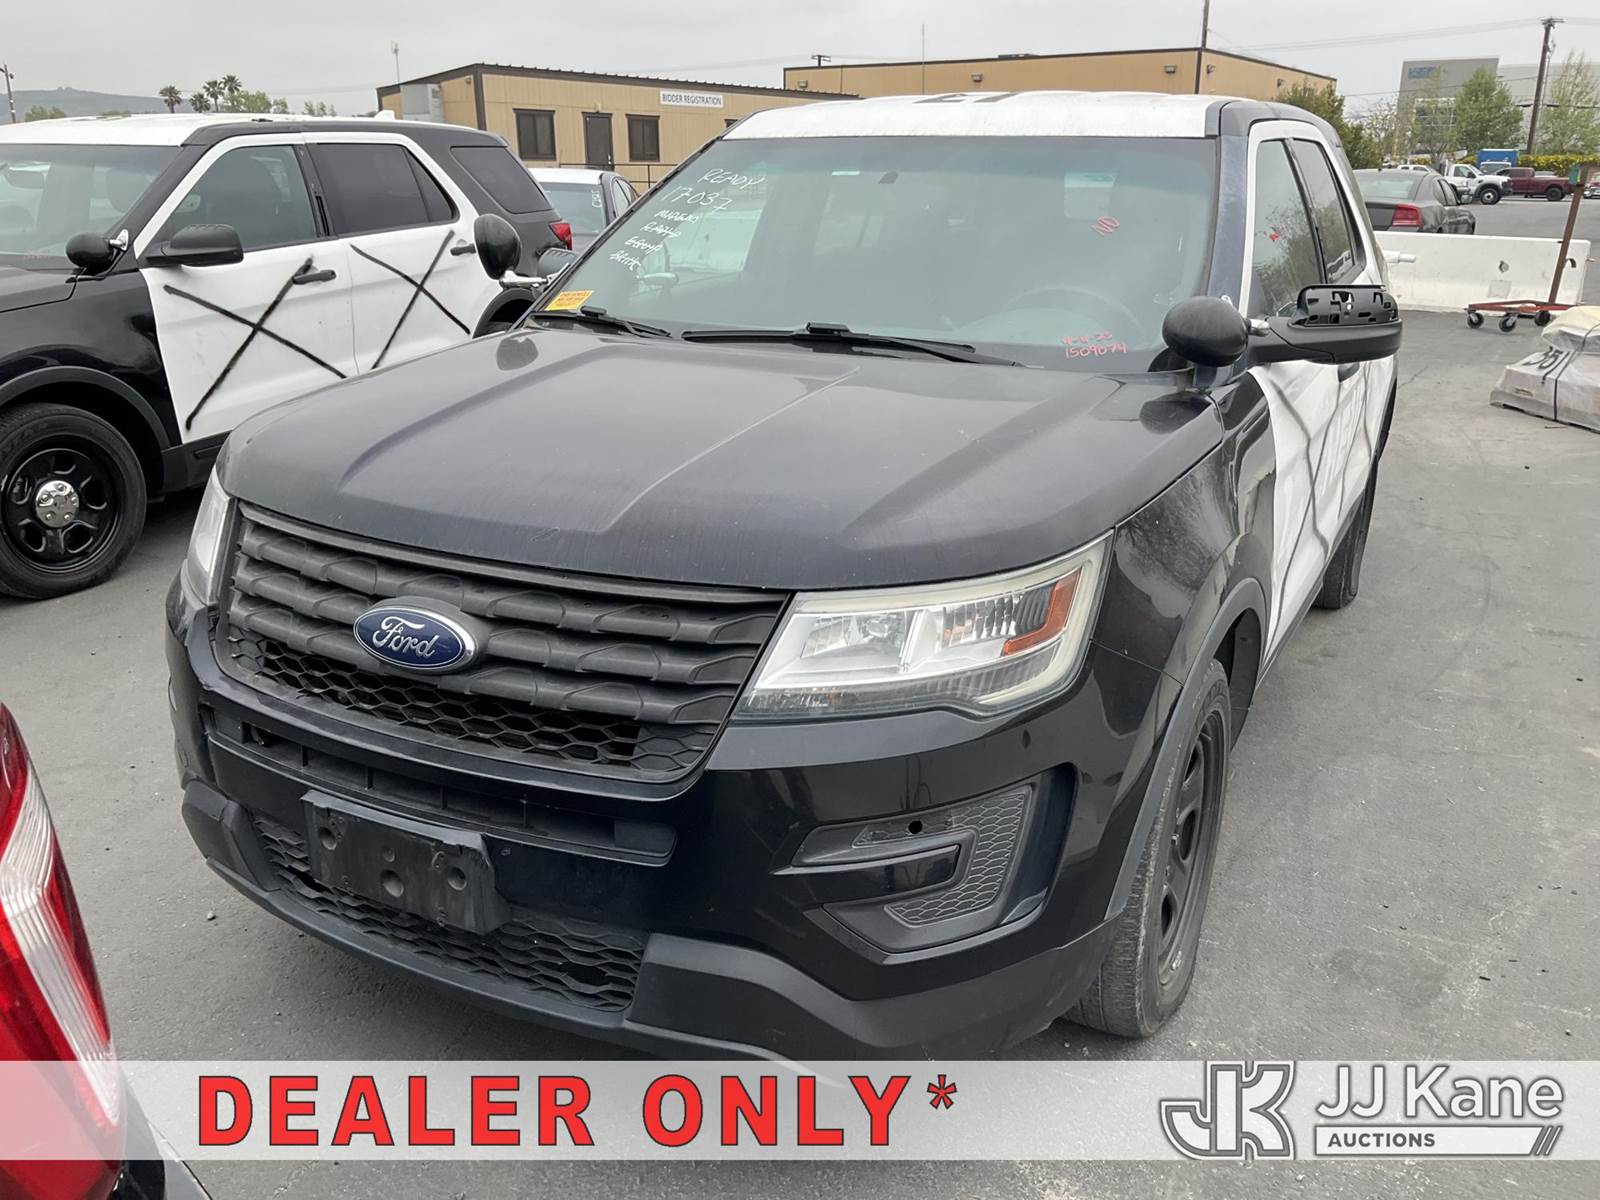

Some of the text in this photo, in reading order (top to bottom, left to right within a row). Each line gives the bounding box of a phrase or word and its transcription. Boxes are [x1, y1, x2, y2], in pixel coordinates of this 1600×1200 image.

[662, 93, 722, 105] BIDDER REGISTRATION
[698, 168, 765, 189] READY
[661, 185, 733, 214] 17037
[372, 616, 439, 659] Ford
